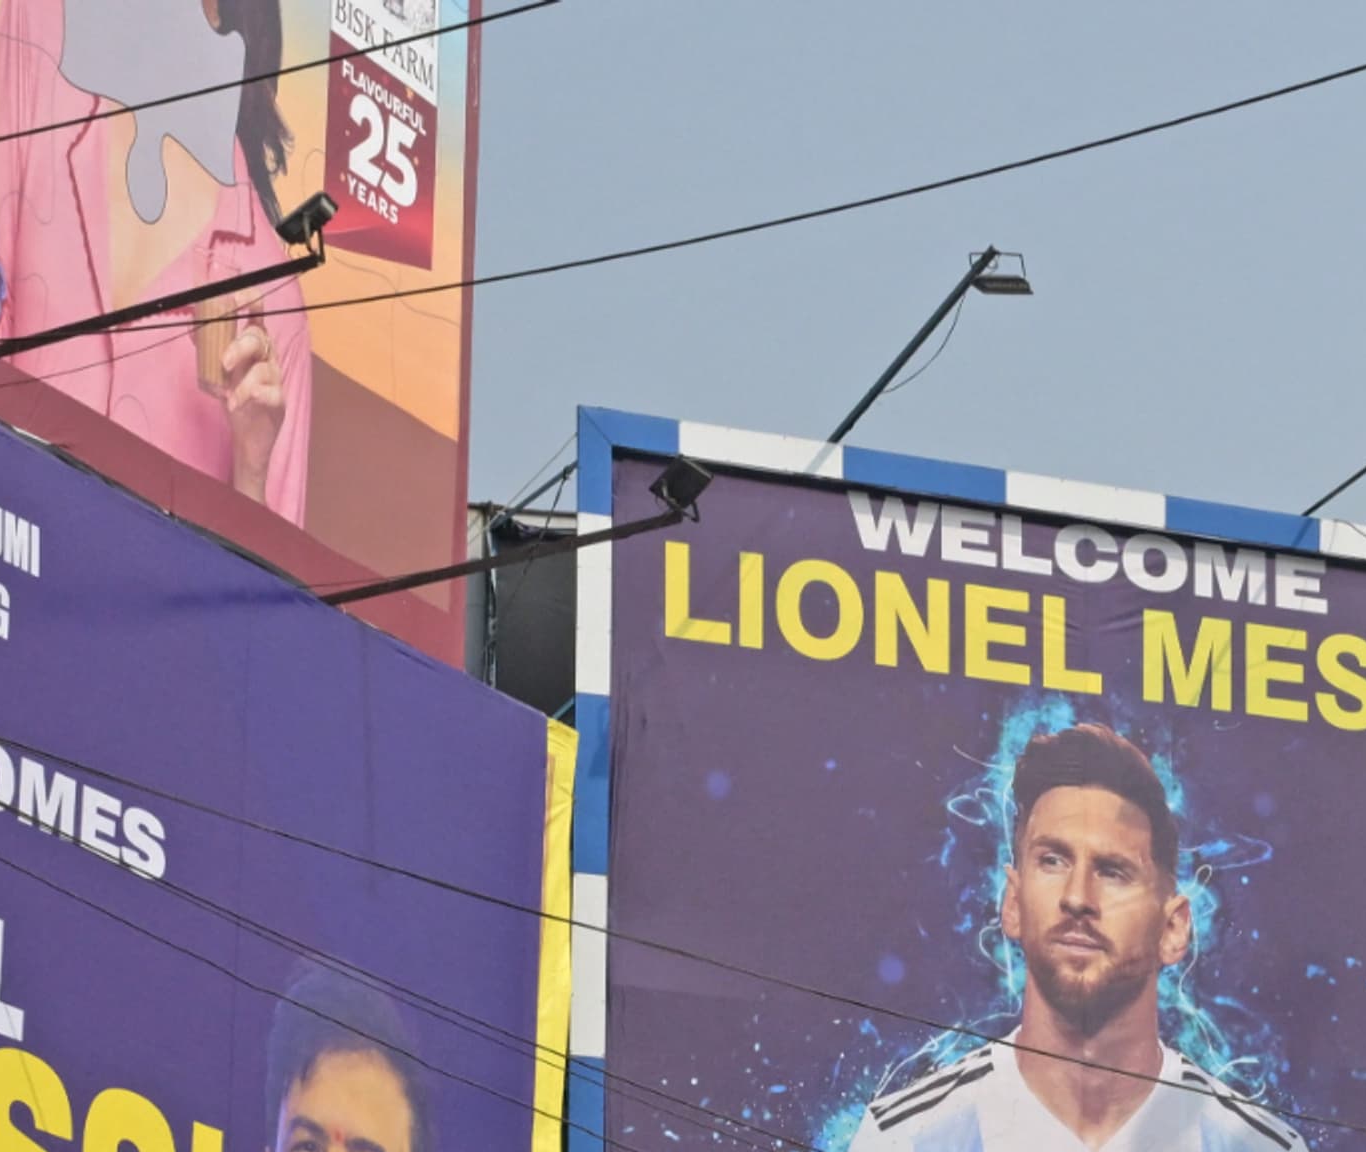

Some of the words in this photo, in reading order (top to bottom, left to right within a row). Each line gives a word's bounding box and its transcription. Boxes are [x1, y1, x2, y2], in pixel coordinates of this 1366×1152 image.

[335, 0, 376, 49] BISK
[382, 26, 435, 92] FARM
[341, 59, 427, 136] FLAVOURFUL
[347, 173, 400, 225] YEARS
[348, 93, 419, 207] 25
[847, 490, 1330, 614] WELCOME
[664, 540, 1104, 696] LIONEL
